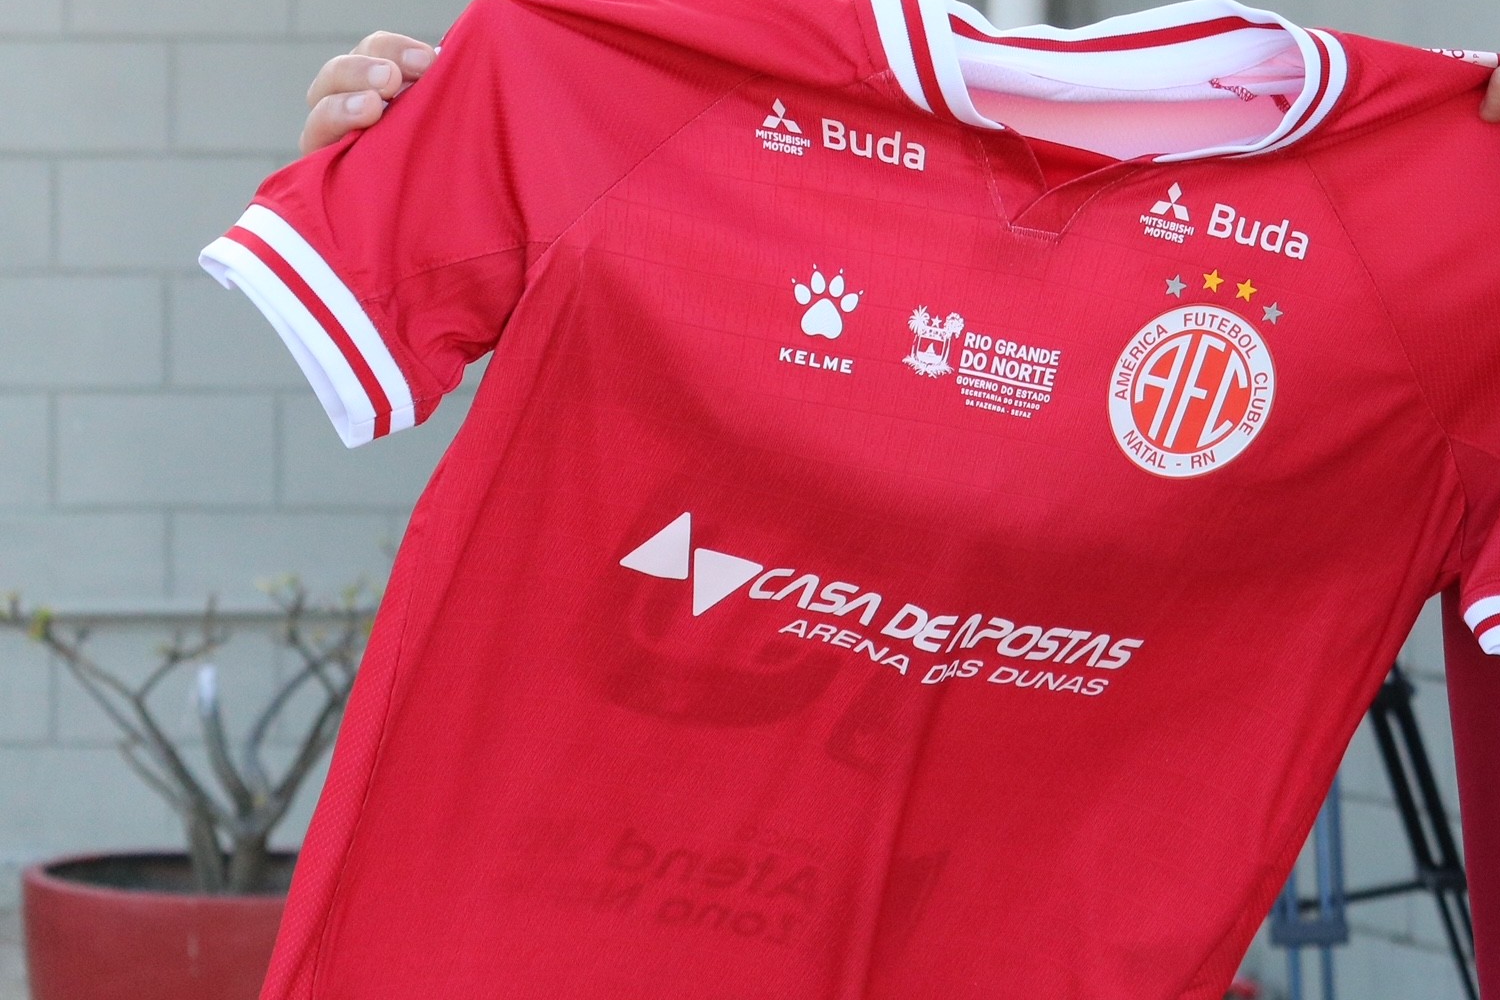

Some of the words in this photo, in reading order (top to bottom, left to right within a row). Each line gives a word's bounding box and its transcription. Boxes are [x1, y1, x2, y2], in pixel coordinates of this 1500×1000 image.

[755, 128, 811, 148] MITSUBISHI
[762, 140, 804, 156] MOTORS
[821, 117, 926, 171] Buda
[1139, 214, 1195, 236] MITSUBISHI
[1143, 226, 1185, 244] MOTORS
[1206, 202, 1310, 260] Buda
[778, 347, 854, 374] KELME
[963, 332, 991, 351] RIO
[994, 339, 1062, 366] GRANDE
[959, 349, 988, 371] DO
[990, 356, 1057, 387] NORTE
[1114, 323, 1169, 401] AMÉRICA
[1182, 311, 1258, 360] FUTEBOL
[1238, 371, 1269, 436] CLUBE
[956, 376, 998, 391] GOVERNO
[1001, 385, 1014, 396] DO
[1016, 389, 1051, 403] ESTADO
[960, 387, 1003, 403] SECRETARIA
[1014, 400, 1040, 410] ESTADO
[1134, 333, 1249, 450] AFC
[975, 400, 1006, 414] FAZENDA
[1122, 429, 1167, 470] NATAL
[1190, 449, 1217, 470] RN
[748, 568, 882, 625] CASA
[778, 618, 910, 675] ARENA
[920, 659, 984, 684] DAS
[987, 666, 1110, 697] DUNAS
